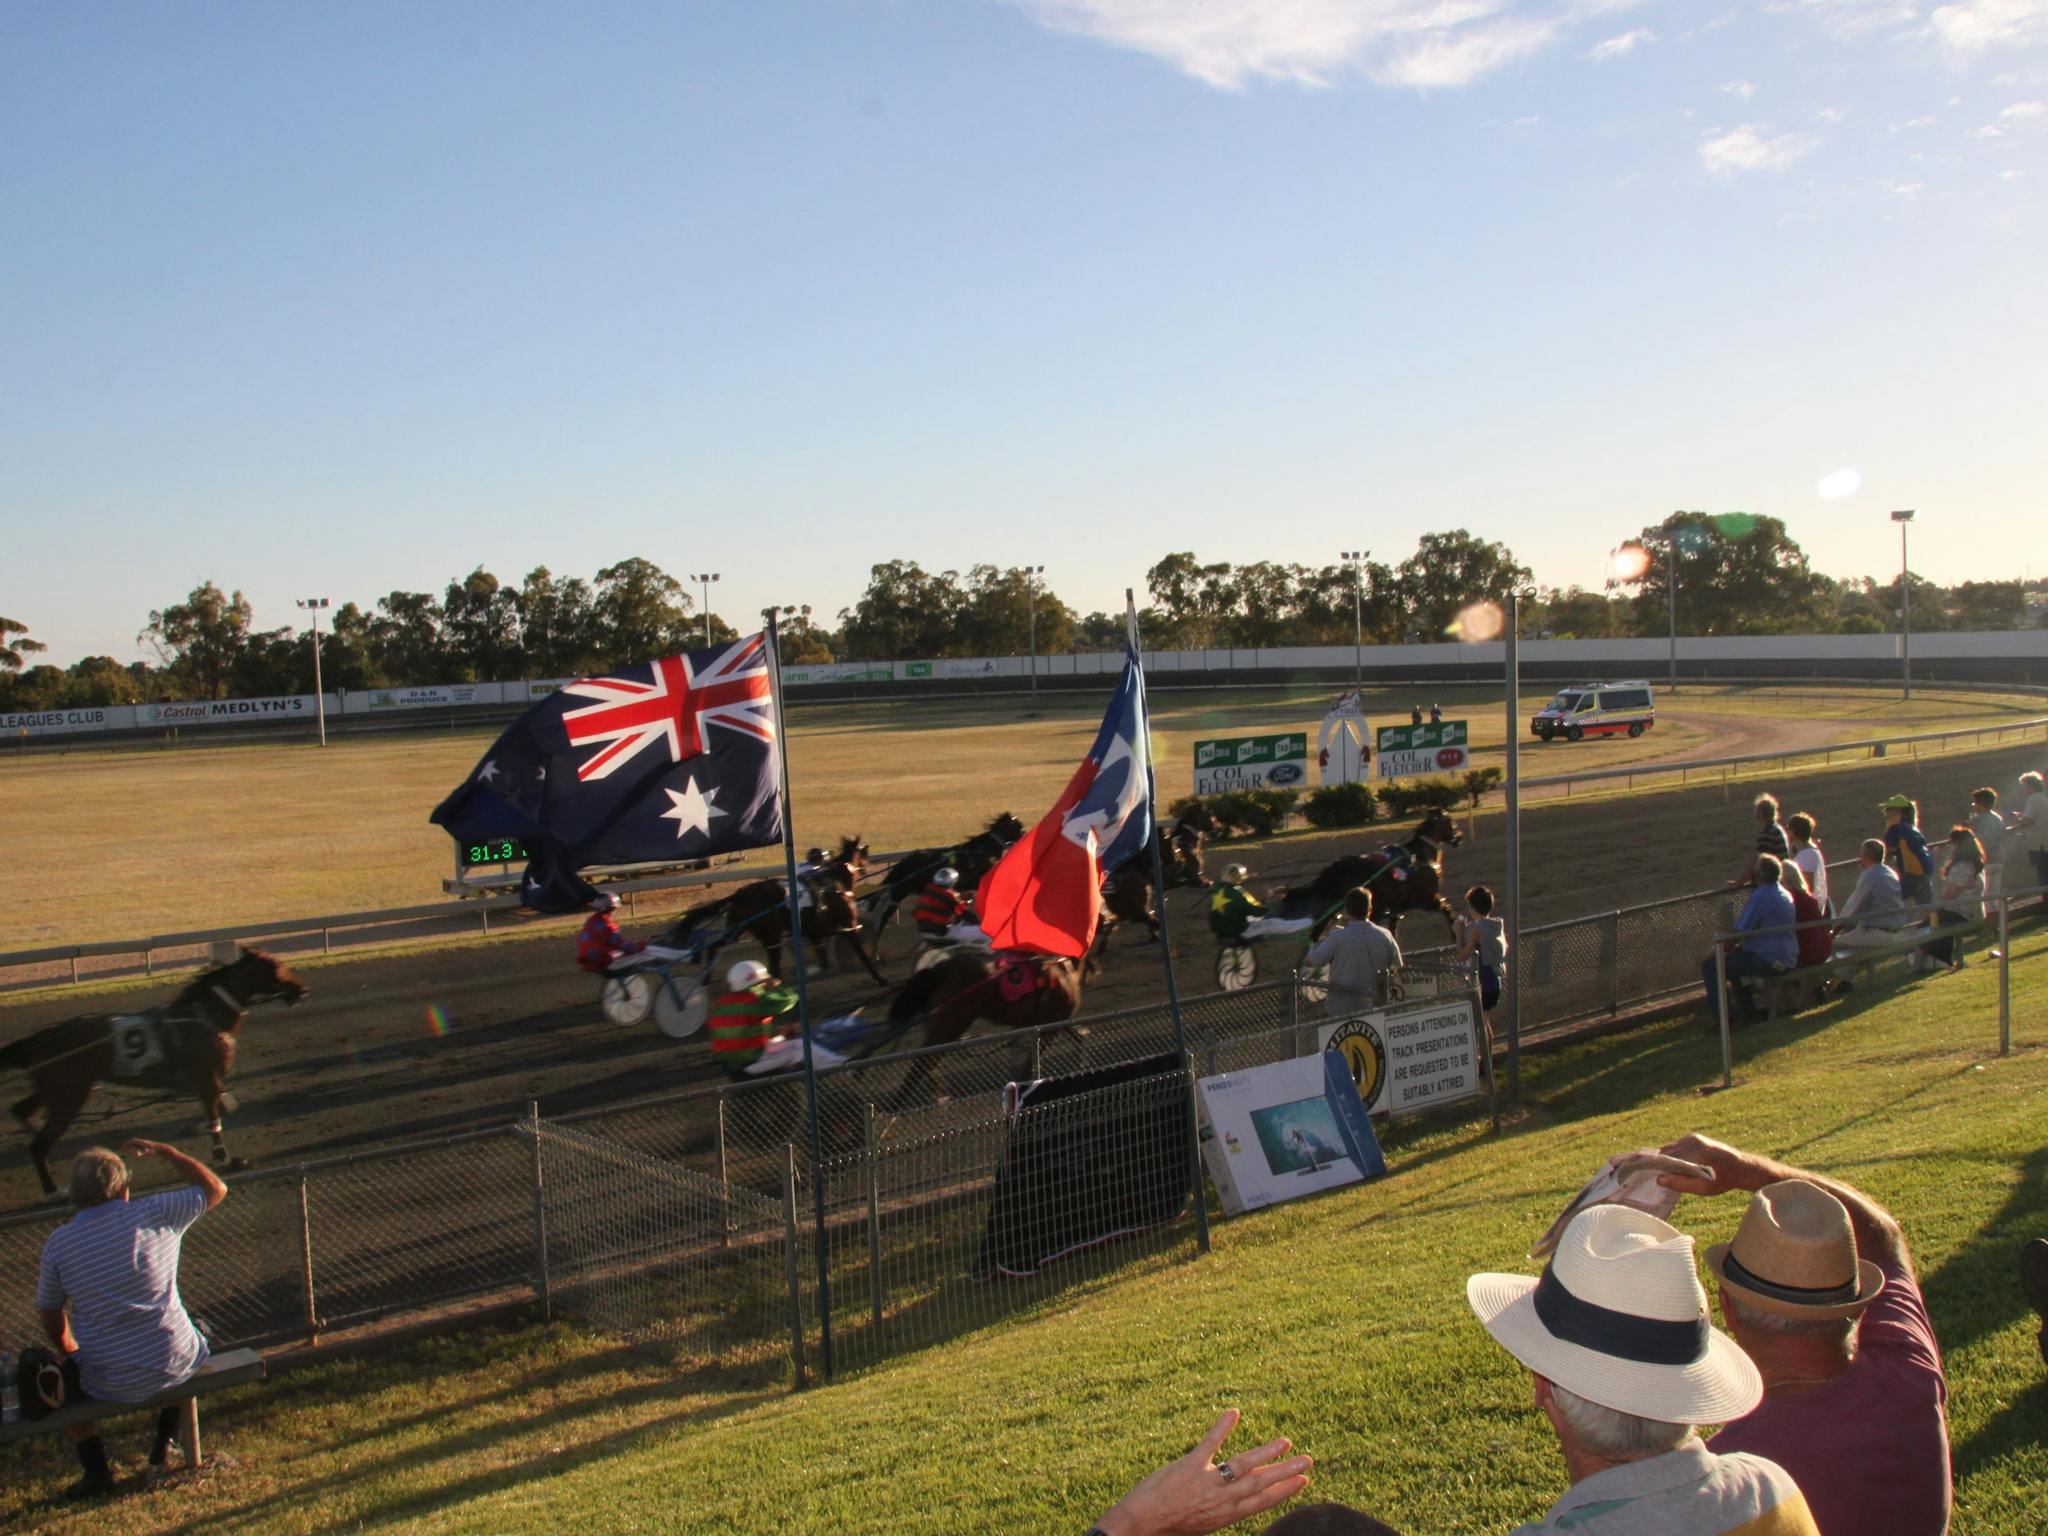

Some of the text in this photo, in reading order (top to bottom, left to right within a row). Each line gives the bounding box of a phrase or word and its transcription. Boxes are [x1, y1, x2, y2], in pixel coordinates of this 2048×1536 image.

[163, 699, 303, 719] Castrol MEDLYN'S
[0, 711, 104, 728] LEAGUES CLUB
[1381, 757, 1432, 777] FLETCHER
[1392, 751, 1418, 763] COL
[1199, 773, 1262, 794] FLETCHER
[1213, 767, 1247, 781] COL
[1274, 767, 1298, 781] Ford
[1388, 1012, 1468, 1039] PERSONS ATTENDING ON
[124, 1029, 148, 1059] 9
[1392, 1033, 1468, 1059] TRACK PRESENTATIONS
[1395, 1053, 1469, 1080] ARE REQUESTED TO BE
[1403, 1075, 1464, 1101] SUITABLY ATTIRED
